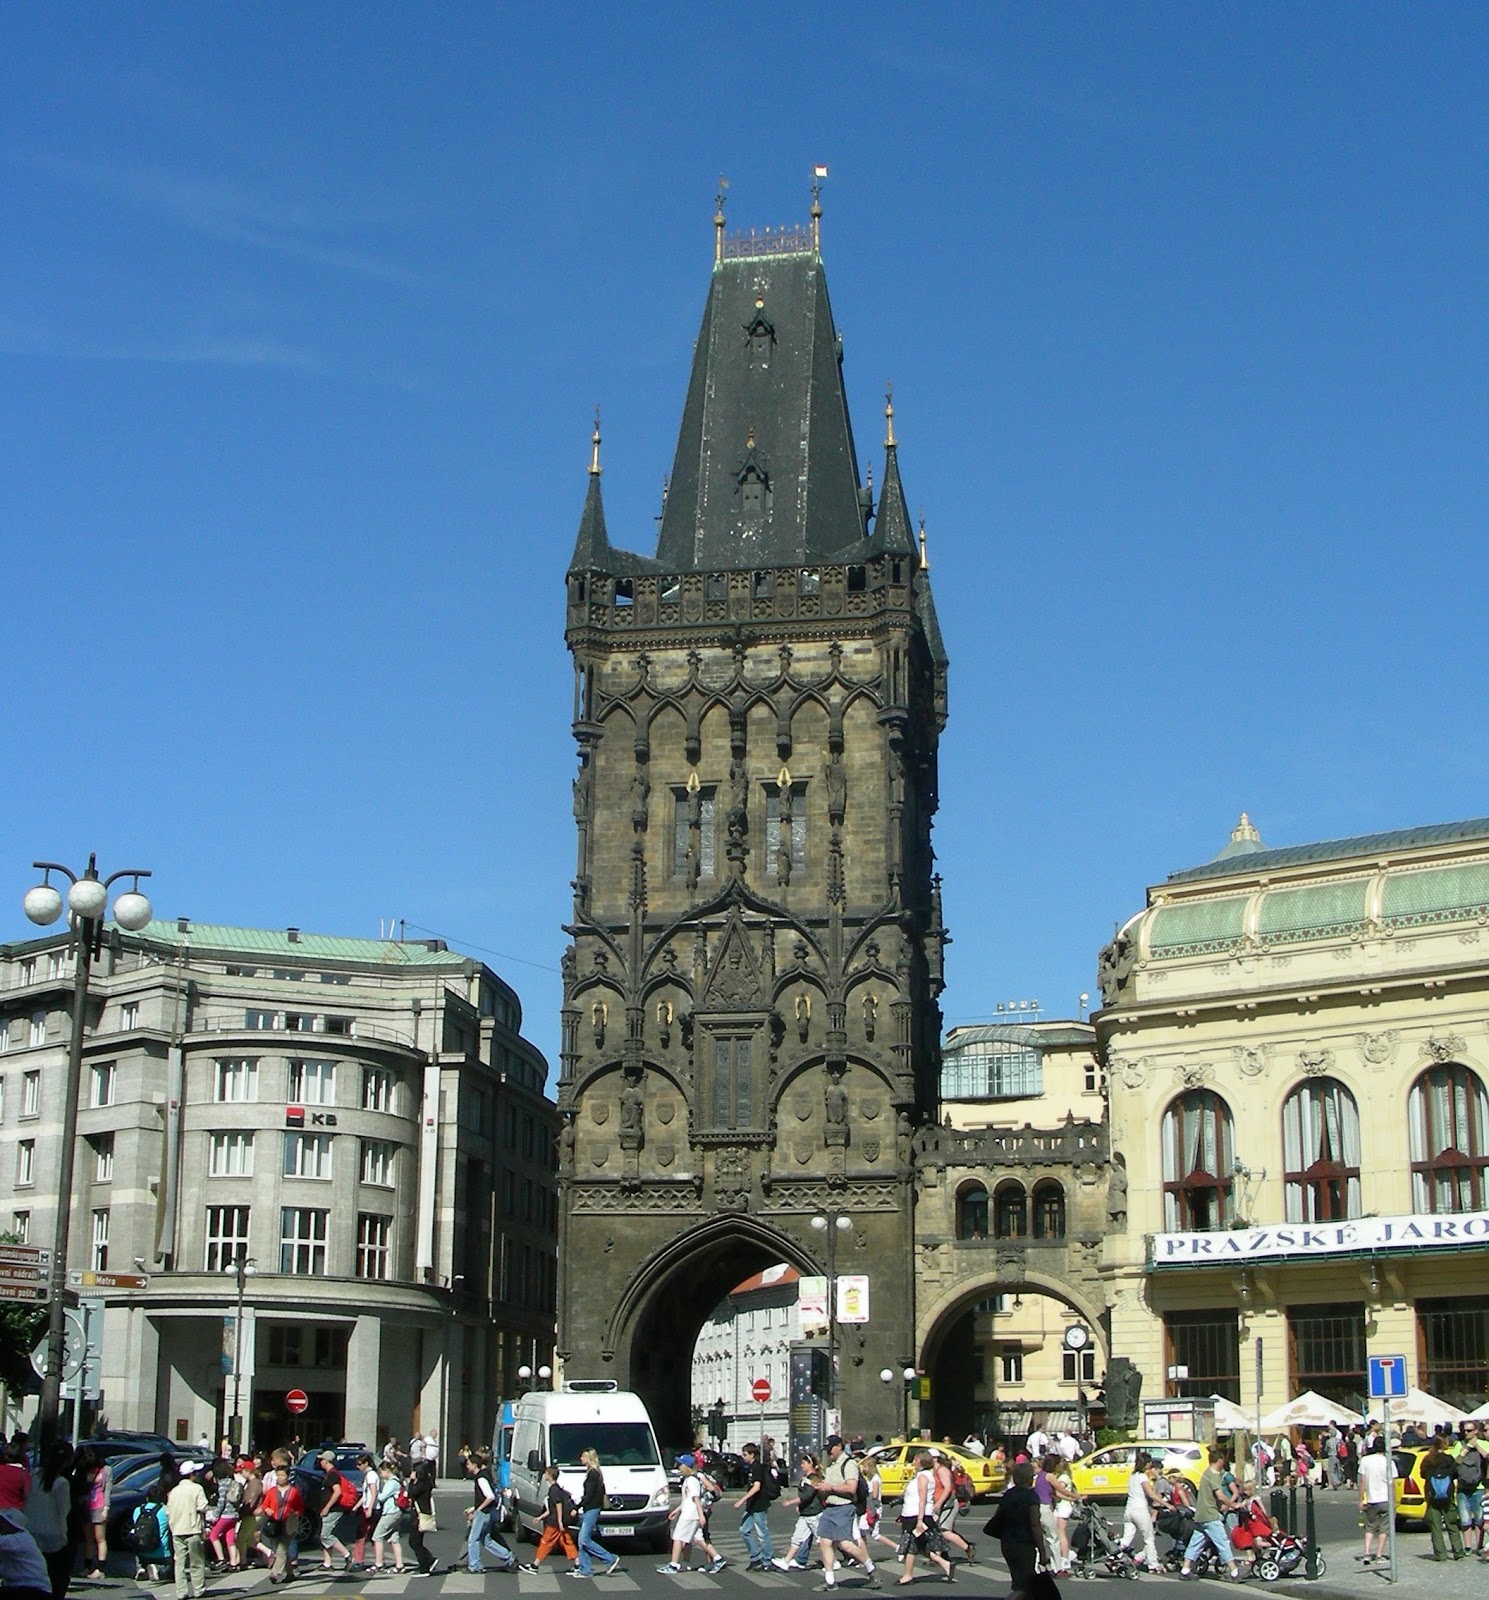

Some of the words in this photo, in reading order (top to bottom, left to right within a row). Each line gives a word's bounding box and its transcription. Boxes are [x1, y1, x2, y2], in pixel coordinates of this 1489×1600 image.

[311, 1112, 338, 1126] KB
[1166, 1224, 1357, 1255] PRAŽSKÉ
[1376, 1218, 1489, 1243] JARO
[96, 1275, 116, 1286] Metro
